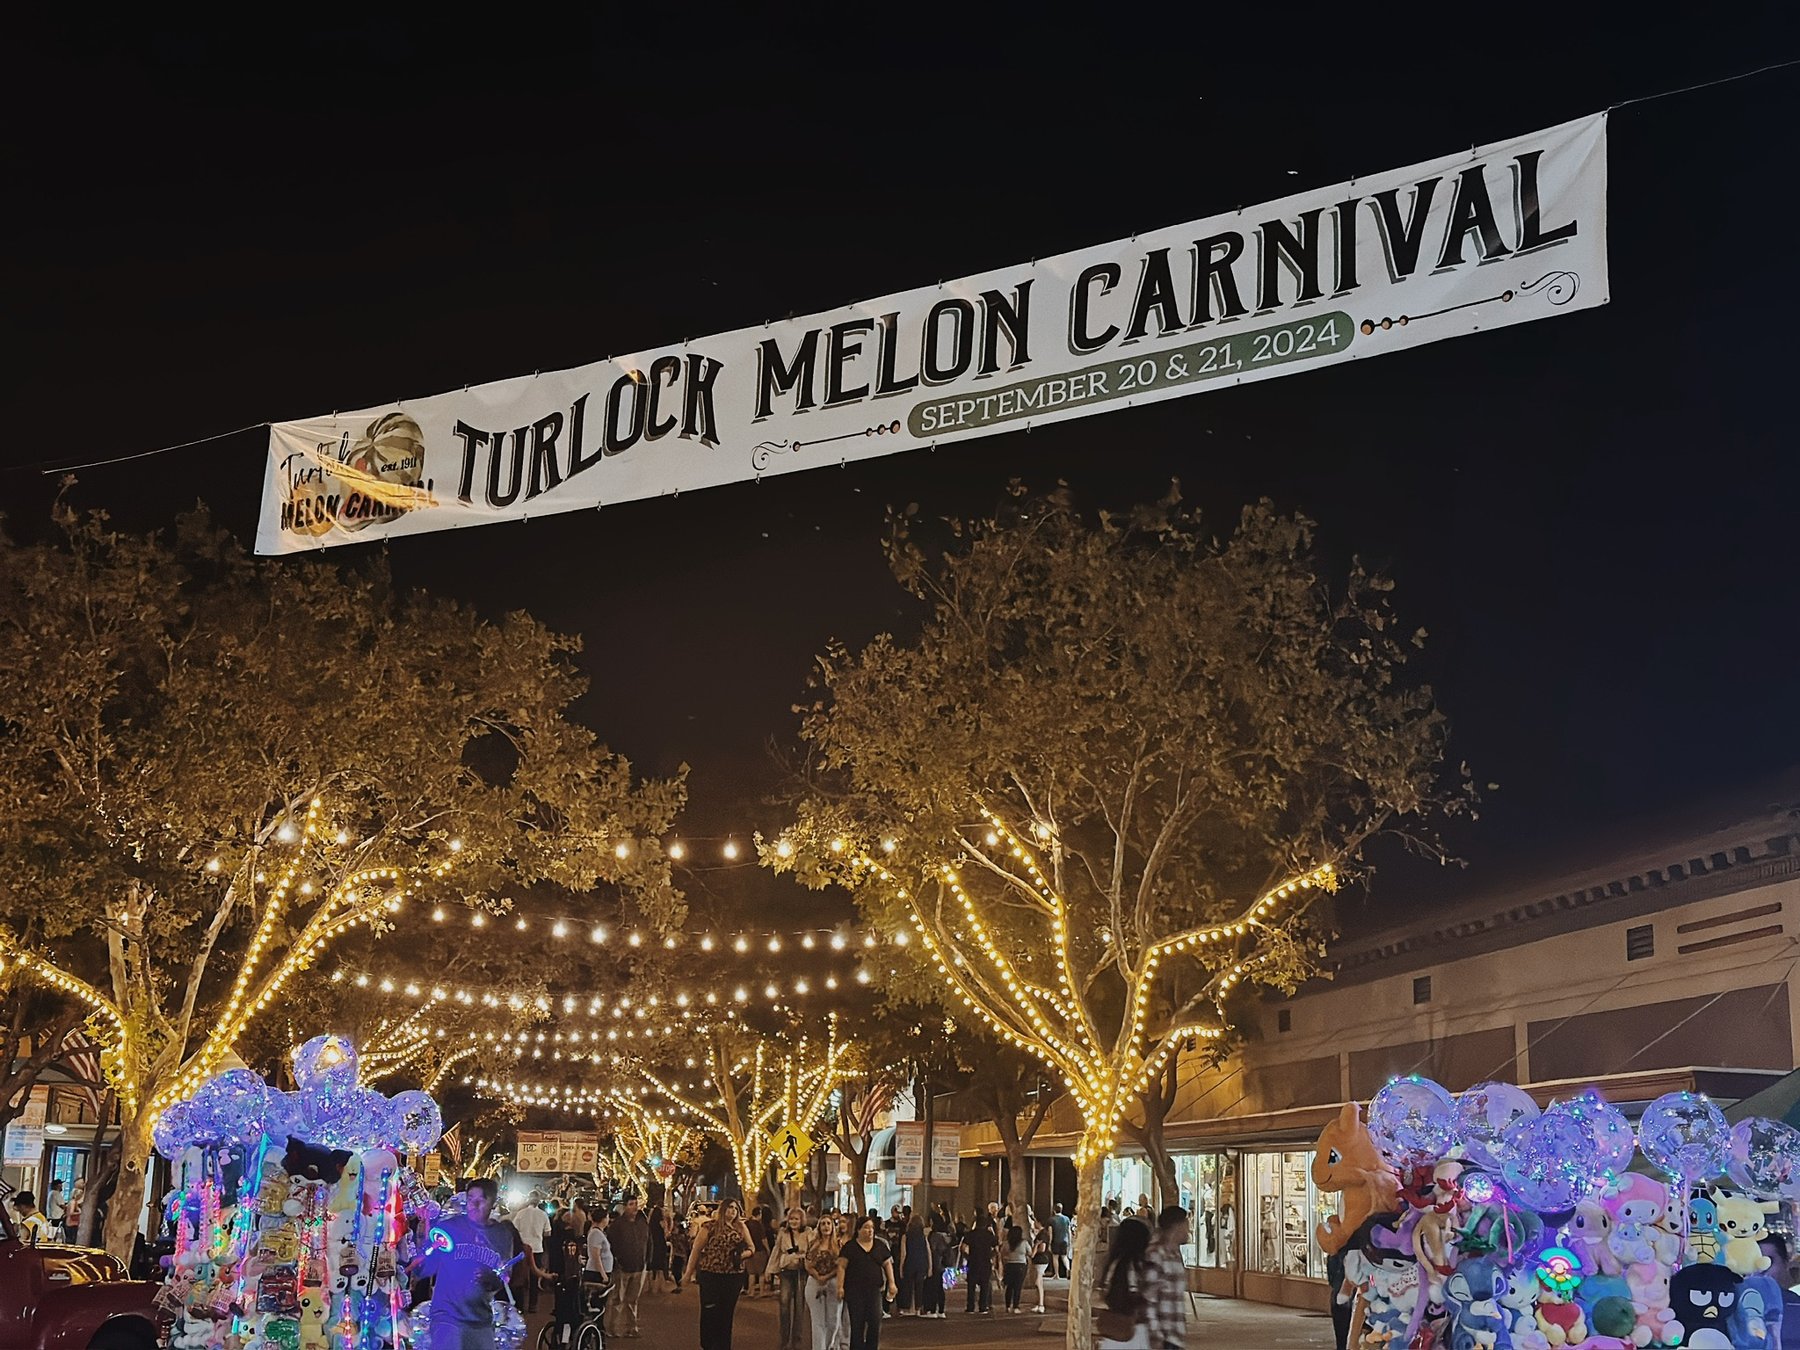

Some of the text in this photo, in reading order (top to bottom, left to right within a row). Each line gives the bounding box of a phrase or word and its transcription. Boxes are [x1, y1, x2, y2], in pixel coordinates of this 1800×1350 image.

[452, 149, 1578, 510] TURLOCK MELON CARNIVAL
[920, 318, 1341, 432] SEPTEMBER 20 & 21, 2024
[399, 457, 418, 471] 1911
[280, 493, 341, 531] MELON
